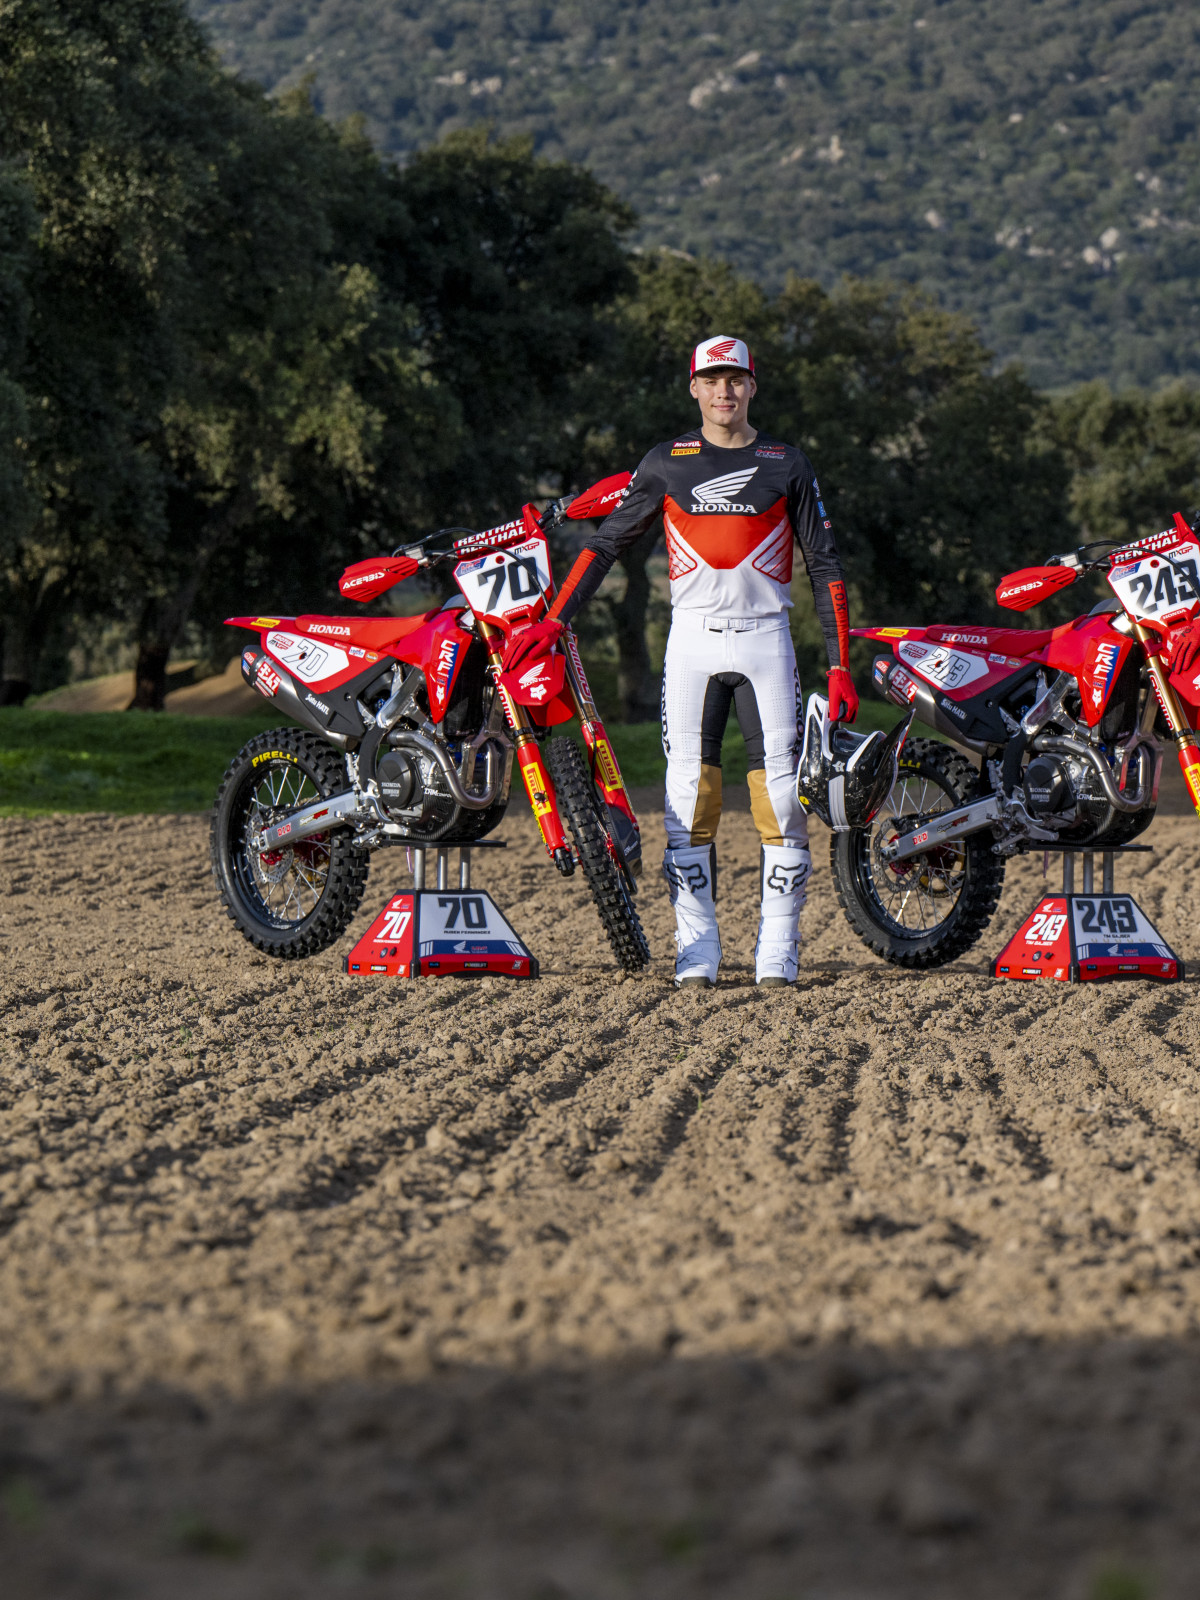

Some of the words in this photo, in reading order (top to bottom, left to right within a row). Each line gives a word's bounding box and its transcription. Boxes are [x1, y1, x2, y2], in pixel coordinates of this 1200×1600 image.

[691, 503, 757, 514] HONDA
[457, 518, 525, 547] RENTHAL
[1112, 528, 1178, 555] NTHAL
[514, 541, 540, 555] MXGP
[1114, 536, 1180, 564] RENTHAL
[1168, 546, 1193, 559] MXGP
[342, 571, 385, 590] ACERBIS
[477, 556, 540, 614] 70
[1000, 580, 1043, 598] ACERBIS
[1129, 559, 1200, 615] 243
[504, 605, 529, 616] HONDA
[832, 583, 846, 612] FOX
[1162, 608, 1186, 619] HONDA
[307, 624, 351, 636] HONDA
[940, 633, 988, 645] HONDA
[282, 639, 328, 677] 70
[437, 639, 457, 672] CRF
[916, 646, 971, 688] 243
[1094, 643, 1116, 675] CRF
[520, 676, 551, 689] HONDA
[252, 751, 298, 768] PIRELLI
[599, 744, 619, 787] PIRELLI
[526, 767, 547, 811] PIREI
[913, 832, 928, 845] DID
[376, 910, 412, 939] 70
[437, 897, 488, 929] 70
[1075, 900, 1138, 933] 243
[1024, 914, 1067, 941] 243
